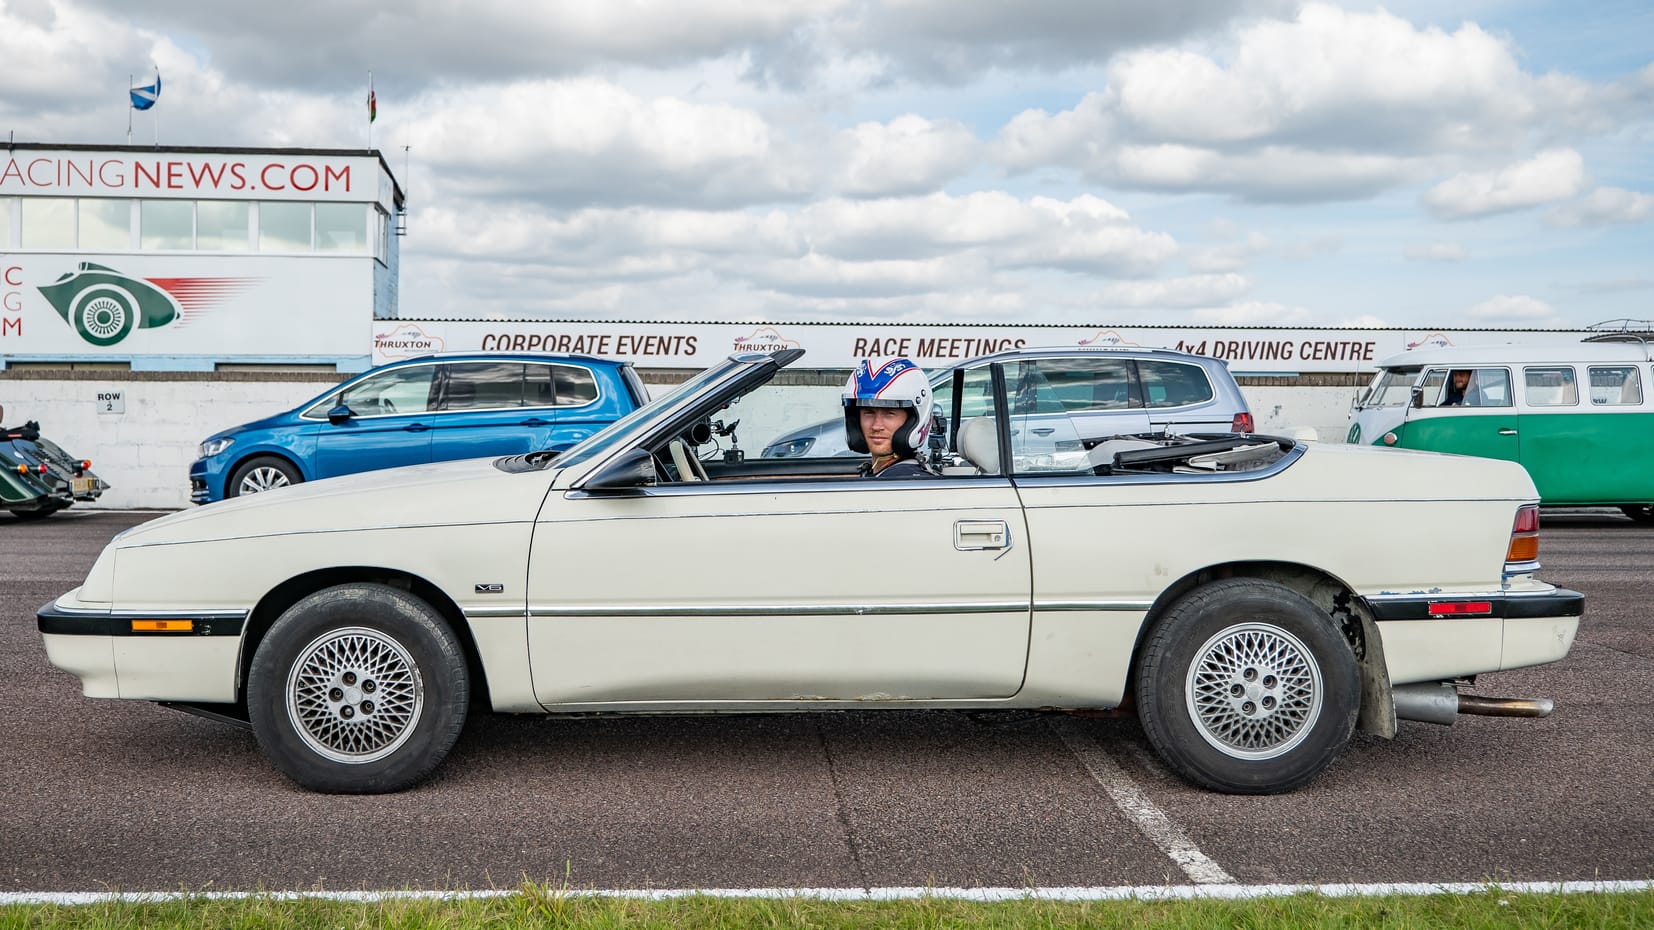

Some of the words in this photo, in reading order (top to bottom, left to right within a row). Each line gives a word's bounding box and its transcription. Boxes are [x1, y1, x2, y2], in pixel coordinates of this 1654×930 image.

[374, 340, 431, 349] THRUXTON
[481, 334, 611, 355] CORPORATE
[615, 335, 698, 356] EVENTS
[733, 343, 788, 352] THRUXTON
[853, 338, 912, 358] RACE
[1212, 340, 1294, 361] DRIVING
[1299, 341, 1376, 361] CENTRE
[97, 392, 121, 401] ROW
[106, 403, 113, 411] 2
